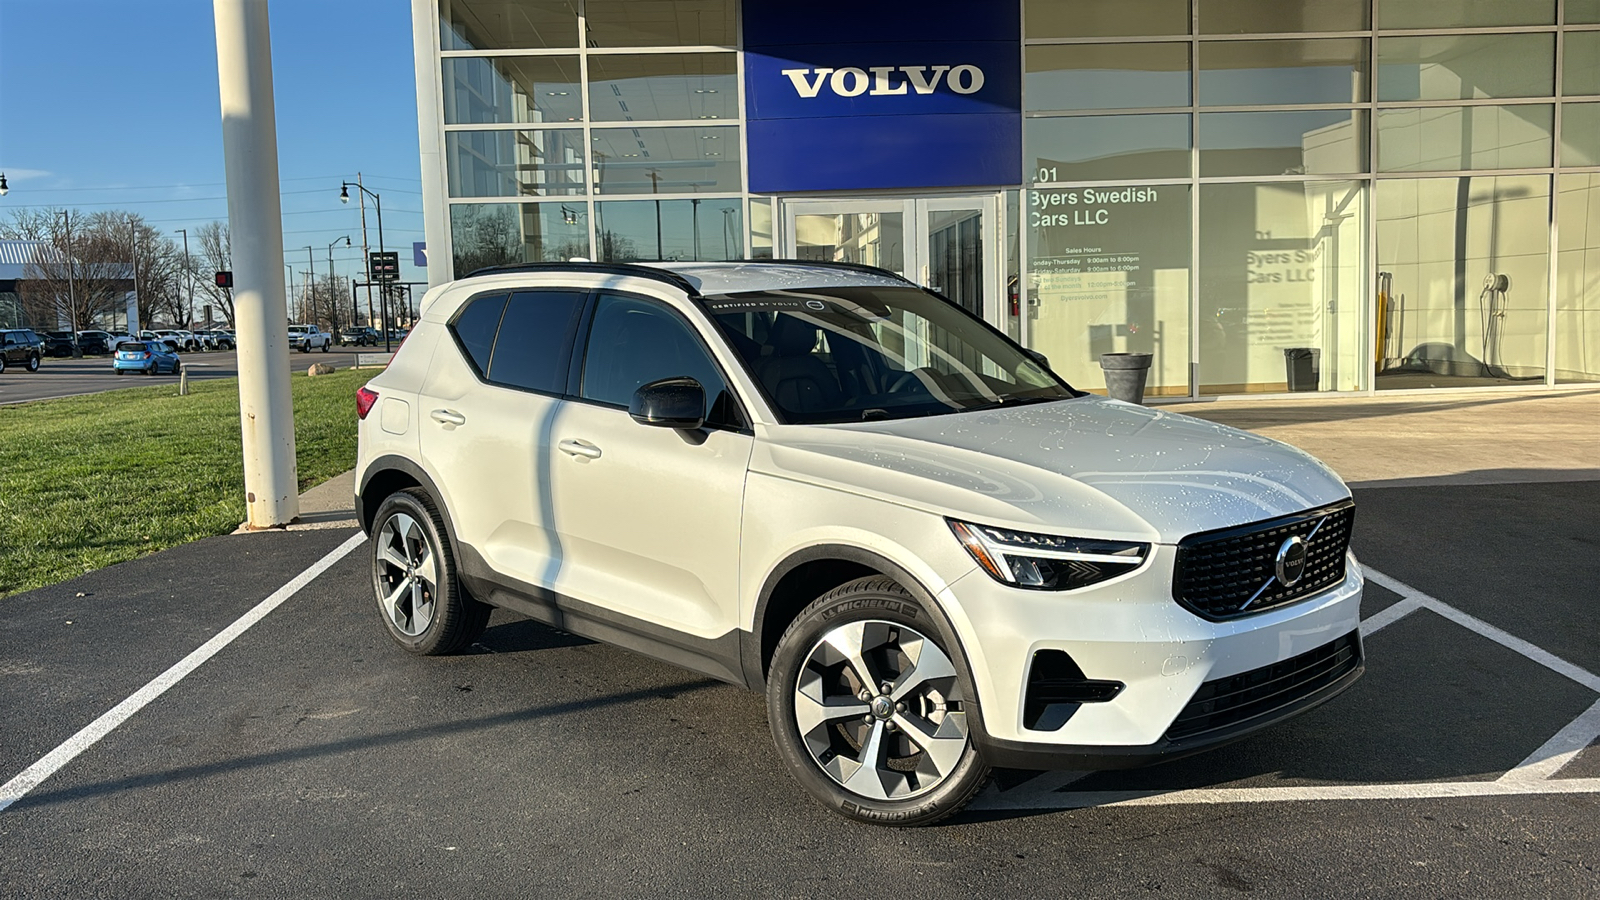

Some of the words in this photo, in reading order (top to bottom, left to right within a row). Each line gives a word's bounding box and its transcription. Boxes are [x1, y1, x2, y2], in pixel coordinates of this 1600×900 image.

[781, 64, 985, 98] VOLVO
[1031, 191, 1078, 209] Byers
[1083, 188, 1158, 204] Swedish
[1031, 212, 1069, 227] Cars
[1074, 209, 1109, 225] LLC
[837, 600, 899, 613] MICHELIN
